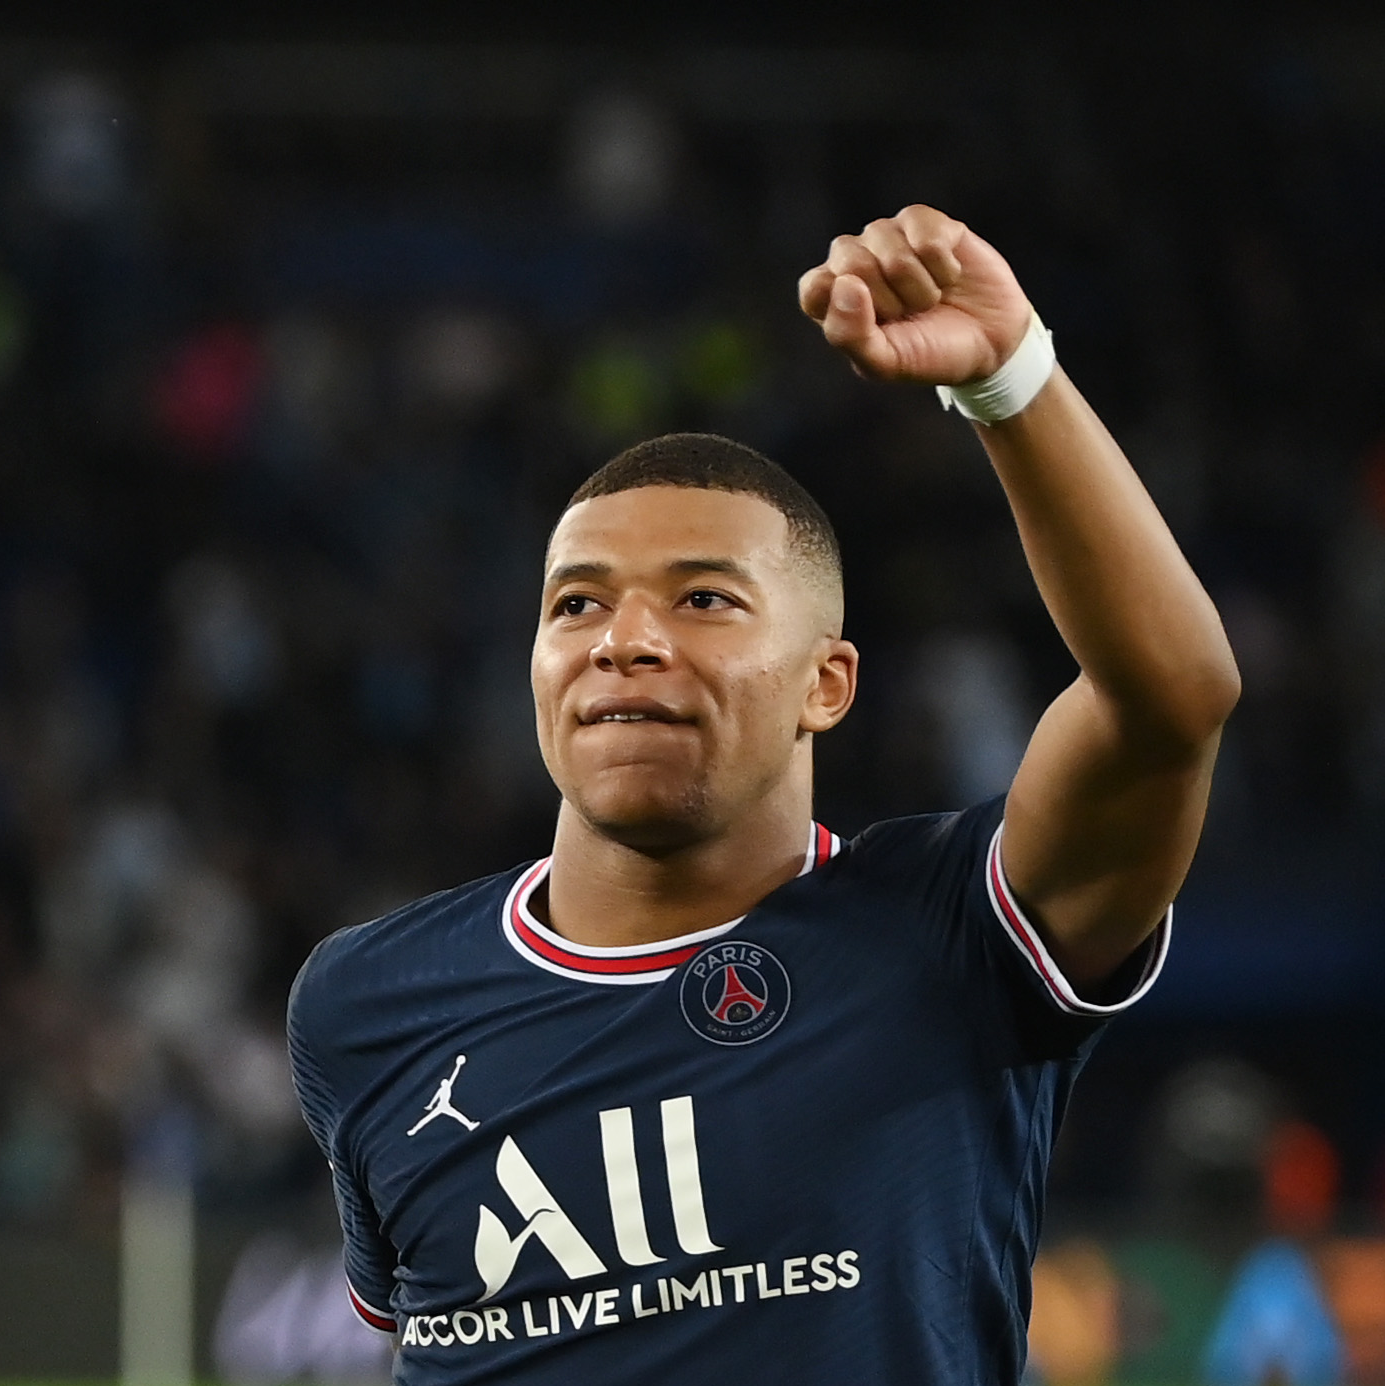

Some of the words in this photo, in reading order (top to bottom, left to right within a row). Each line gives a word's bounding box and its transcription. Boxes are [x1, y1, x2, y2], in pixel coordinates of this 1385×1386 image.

[693, 946, 763, 979] PARIS
[401, 1307, 516, 1348] ACCOR
[521, 1288, 621, 1338] LIVE
[631, 1250, 862, 1319] LIMITLESS
